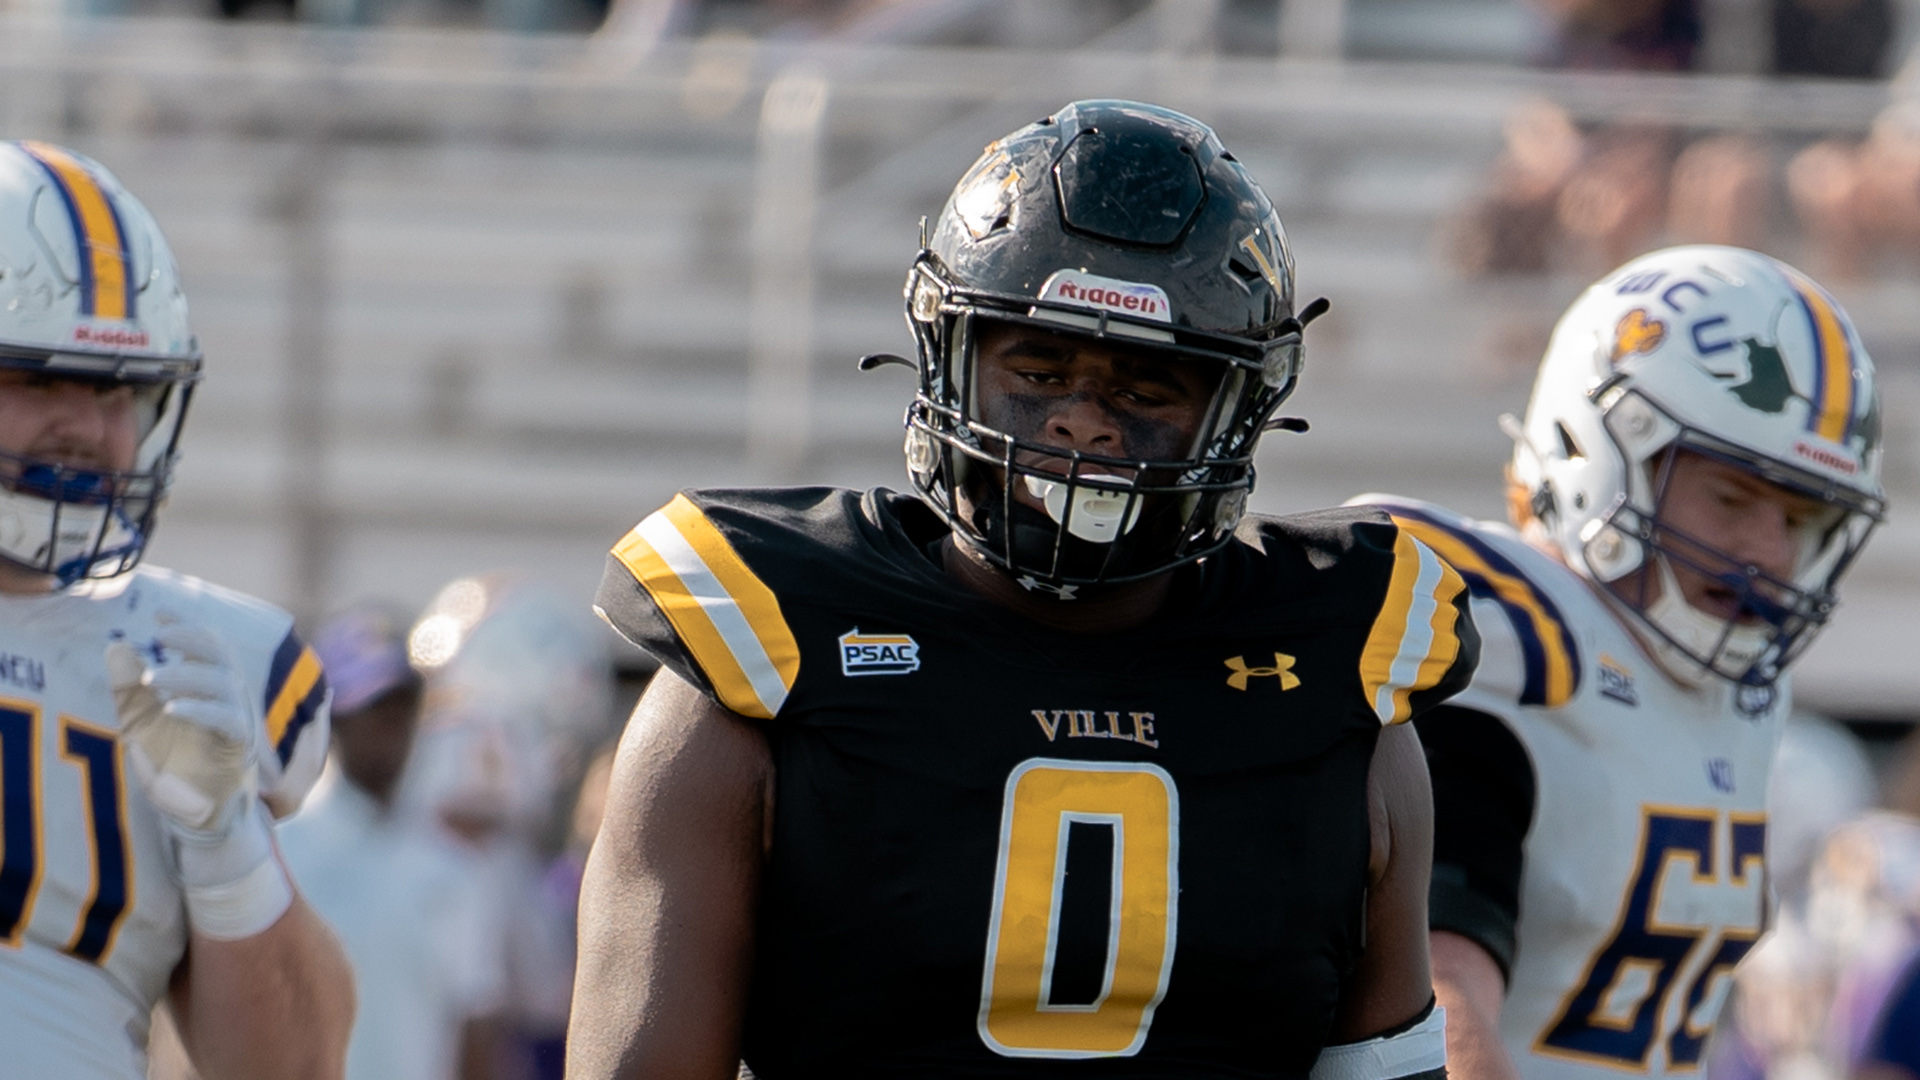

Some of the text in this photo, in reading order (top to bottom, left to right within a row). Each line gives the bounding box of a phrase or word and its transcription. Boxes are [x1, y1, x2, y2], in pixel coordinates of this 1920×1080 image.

[1059, 281, 1156, 313] Riddell
[844, 645, 913, 663] PSAC
[1031, 710, 1159, 749] VILLE
[977, 757, 1180, 1059] 0
